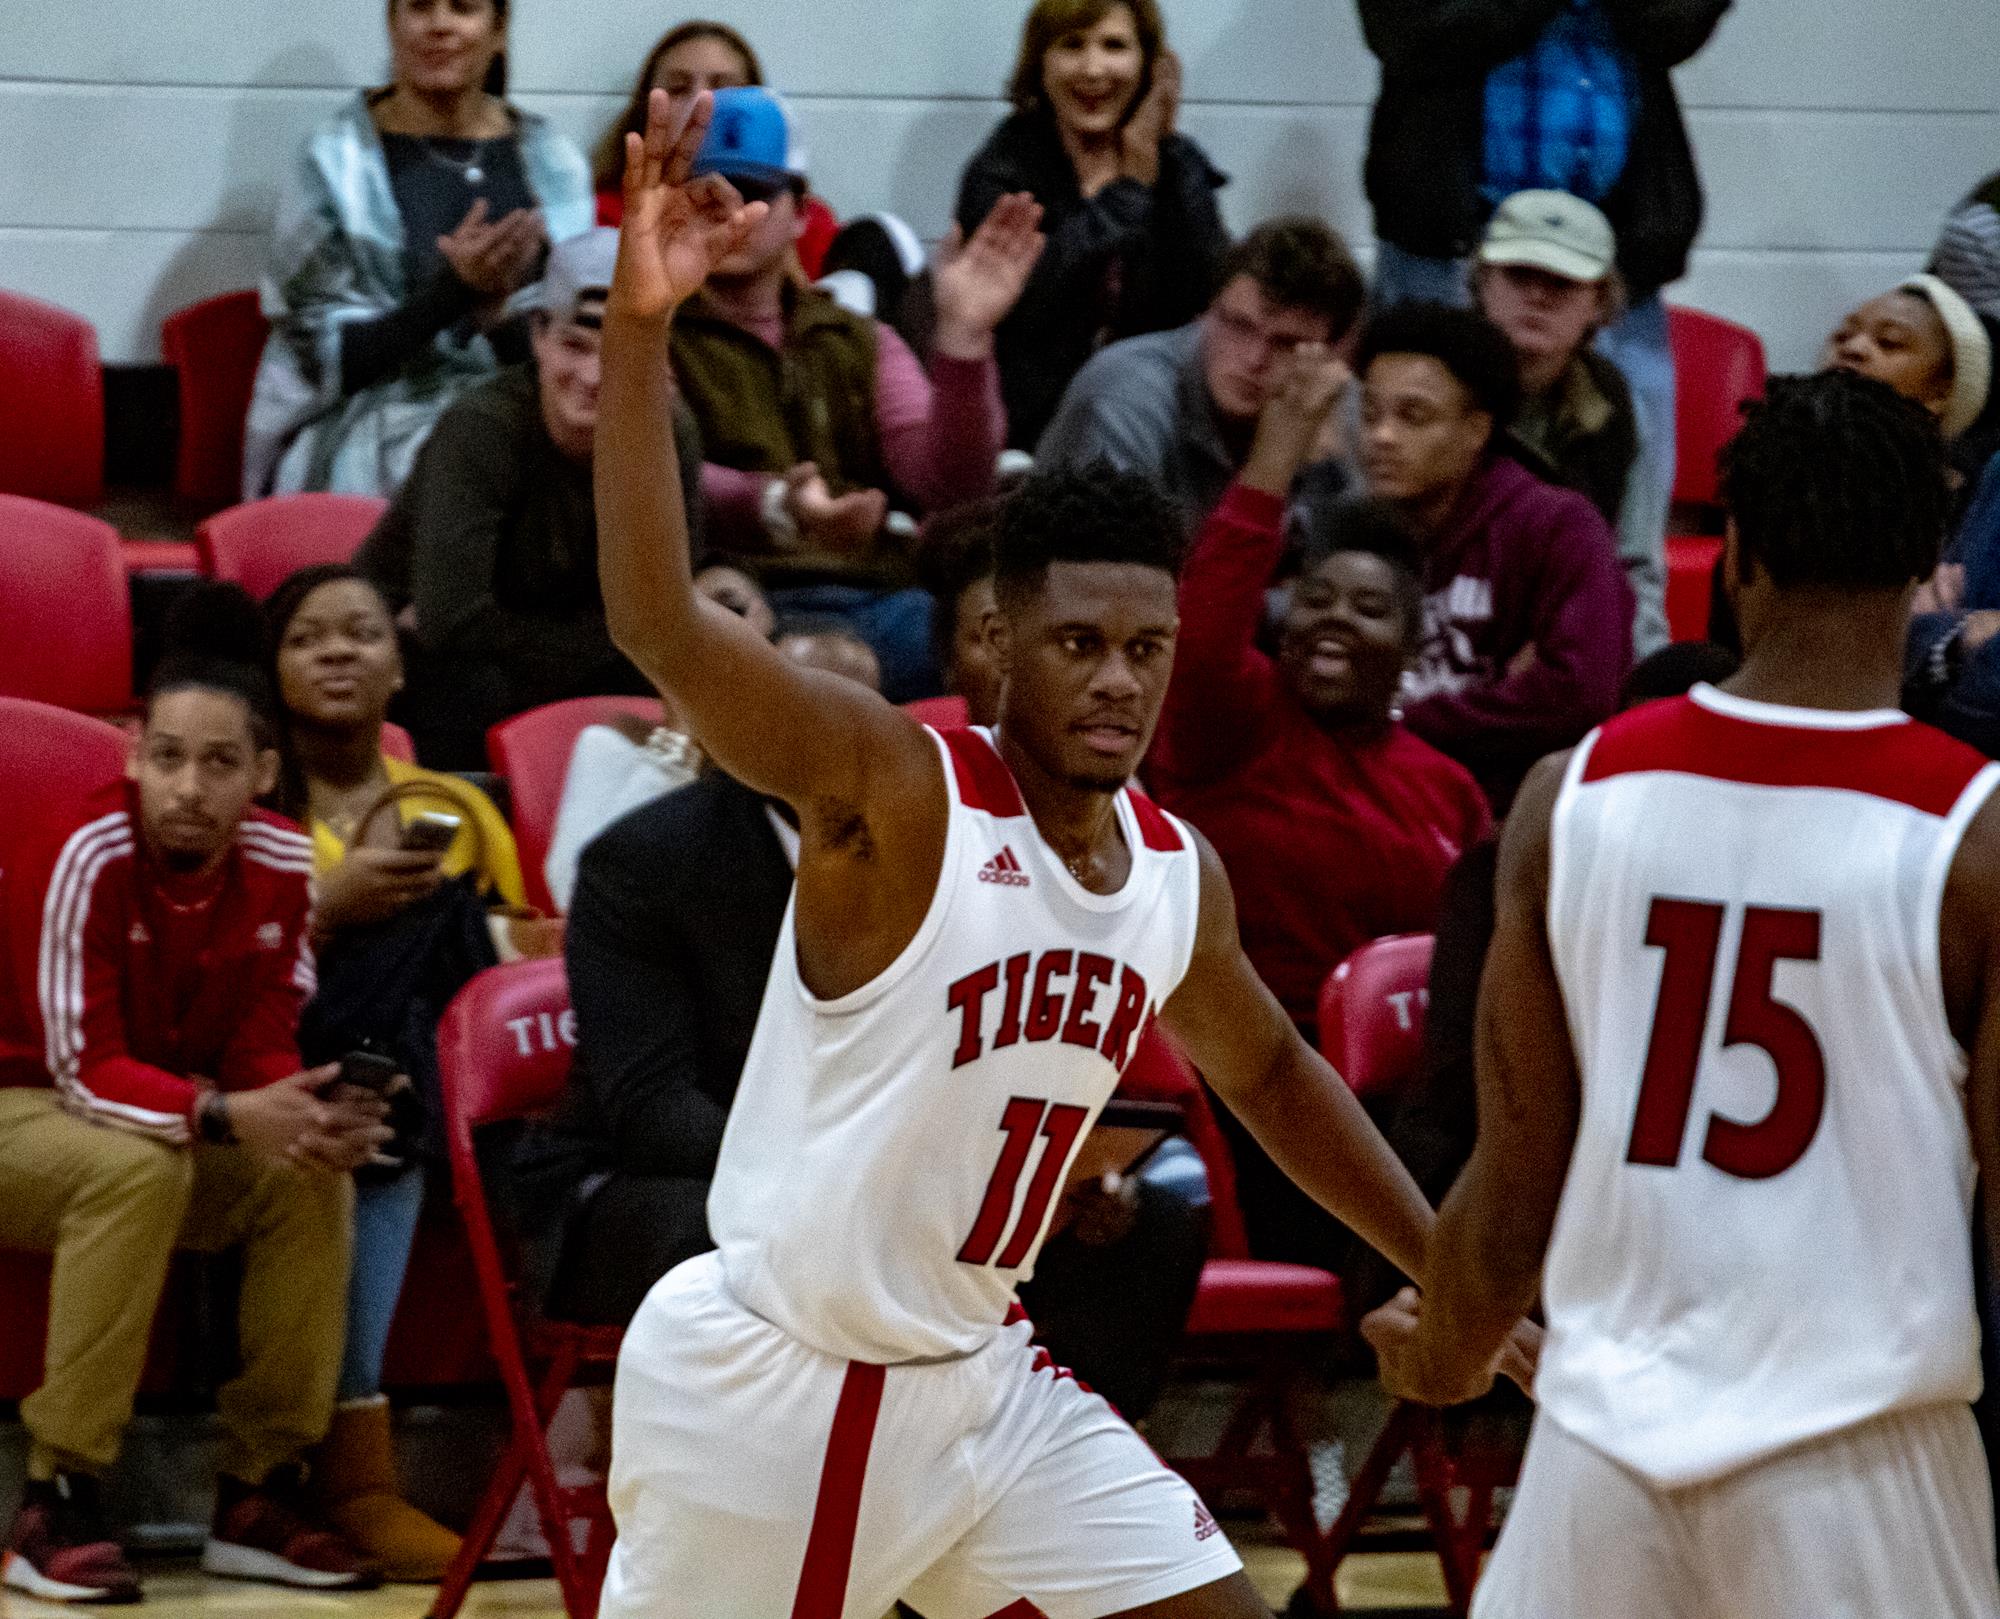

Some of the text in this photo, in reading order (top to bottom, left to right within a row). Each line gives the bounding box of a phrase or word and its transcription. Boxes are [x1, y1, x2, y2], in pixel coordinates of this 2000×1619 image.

[977, 869, 1030, 888] adidas
[1625, 893, 1826, 1181] 15
[955, 1095, 1090, 1269] 11
